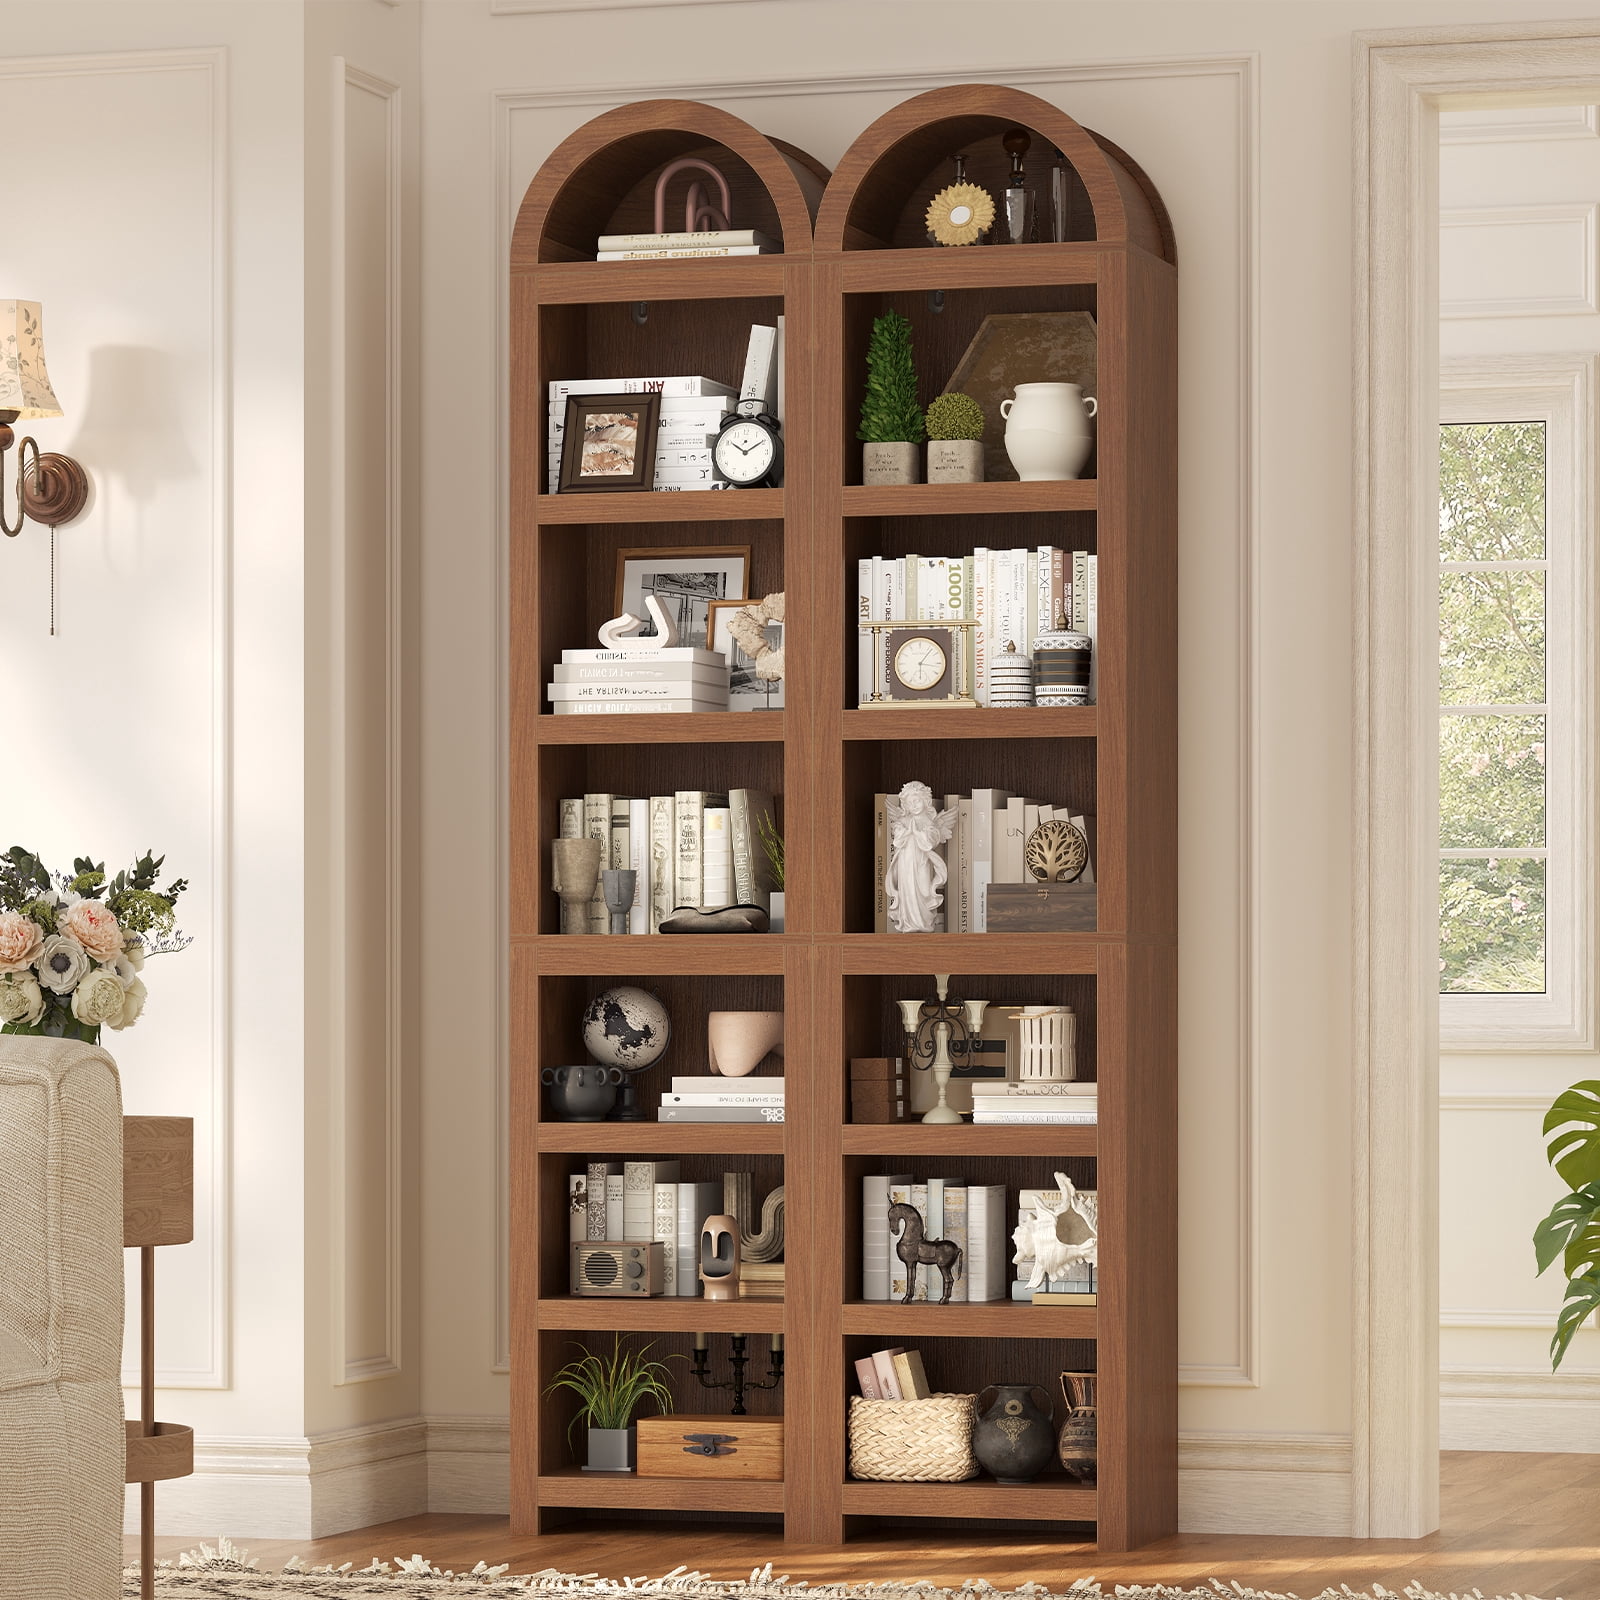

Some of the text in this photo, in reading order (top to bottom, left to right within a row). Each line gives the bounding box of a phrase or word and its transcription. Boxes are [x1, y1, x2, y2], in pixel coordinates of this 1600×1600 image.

[948, 564, 962, 608] 1000
[976, 586, 984, 618] BOOK
[860, 595, 870, 620] ART
[976, 632, 984, 689] SYMBOLS
